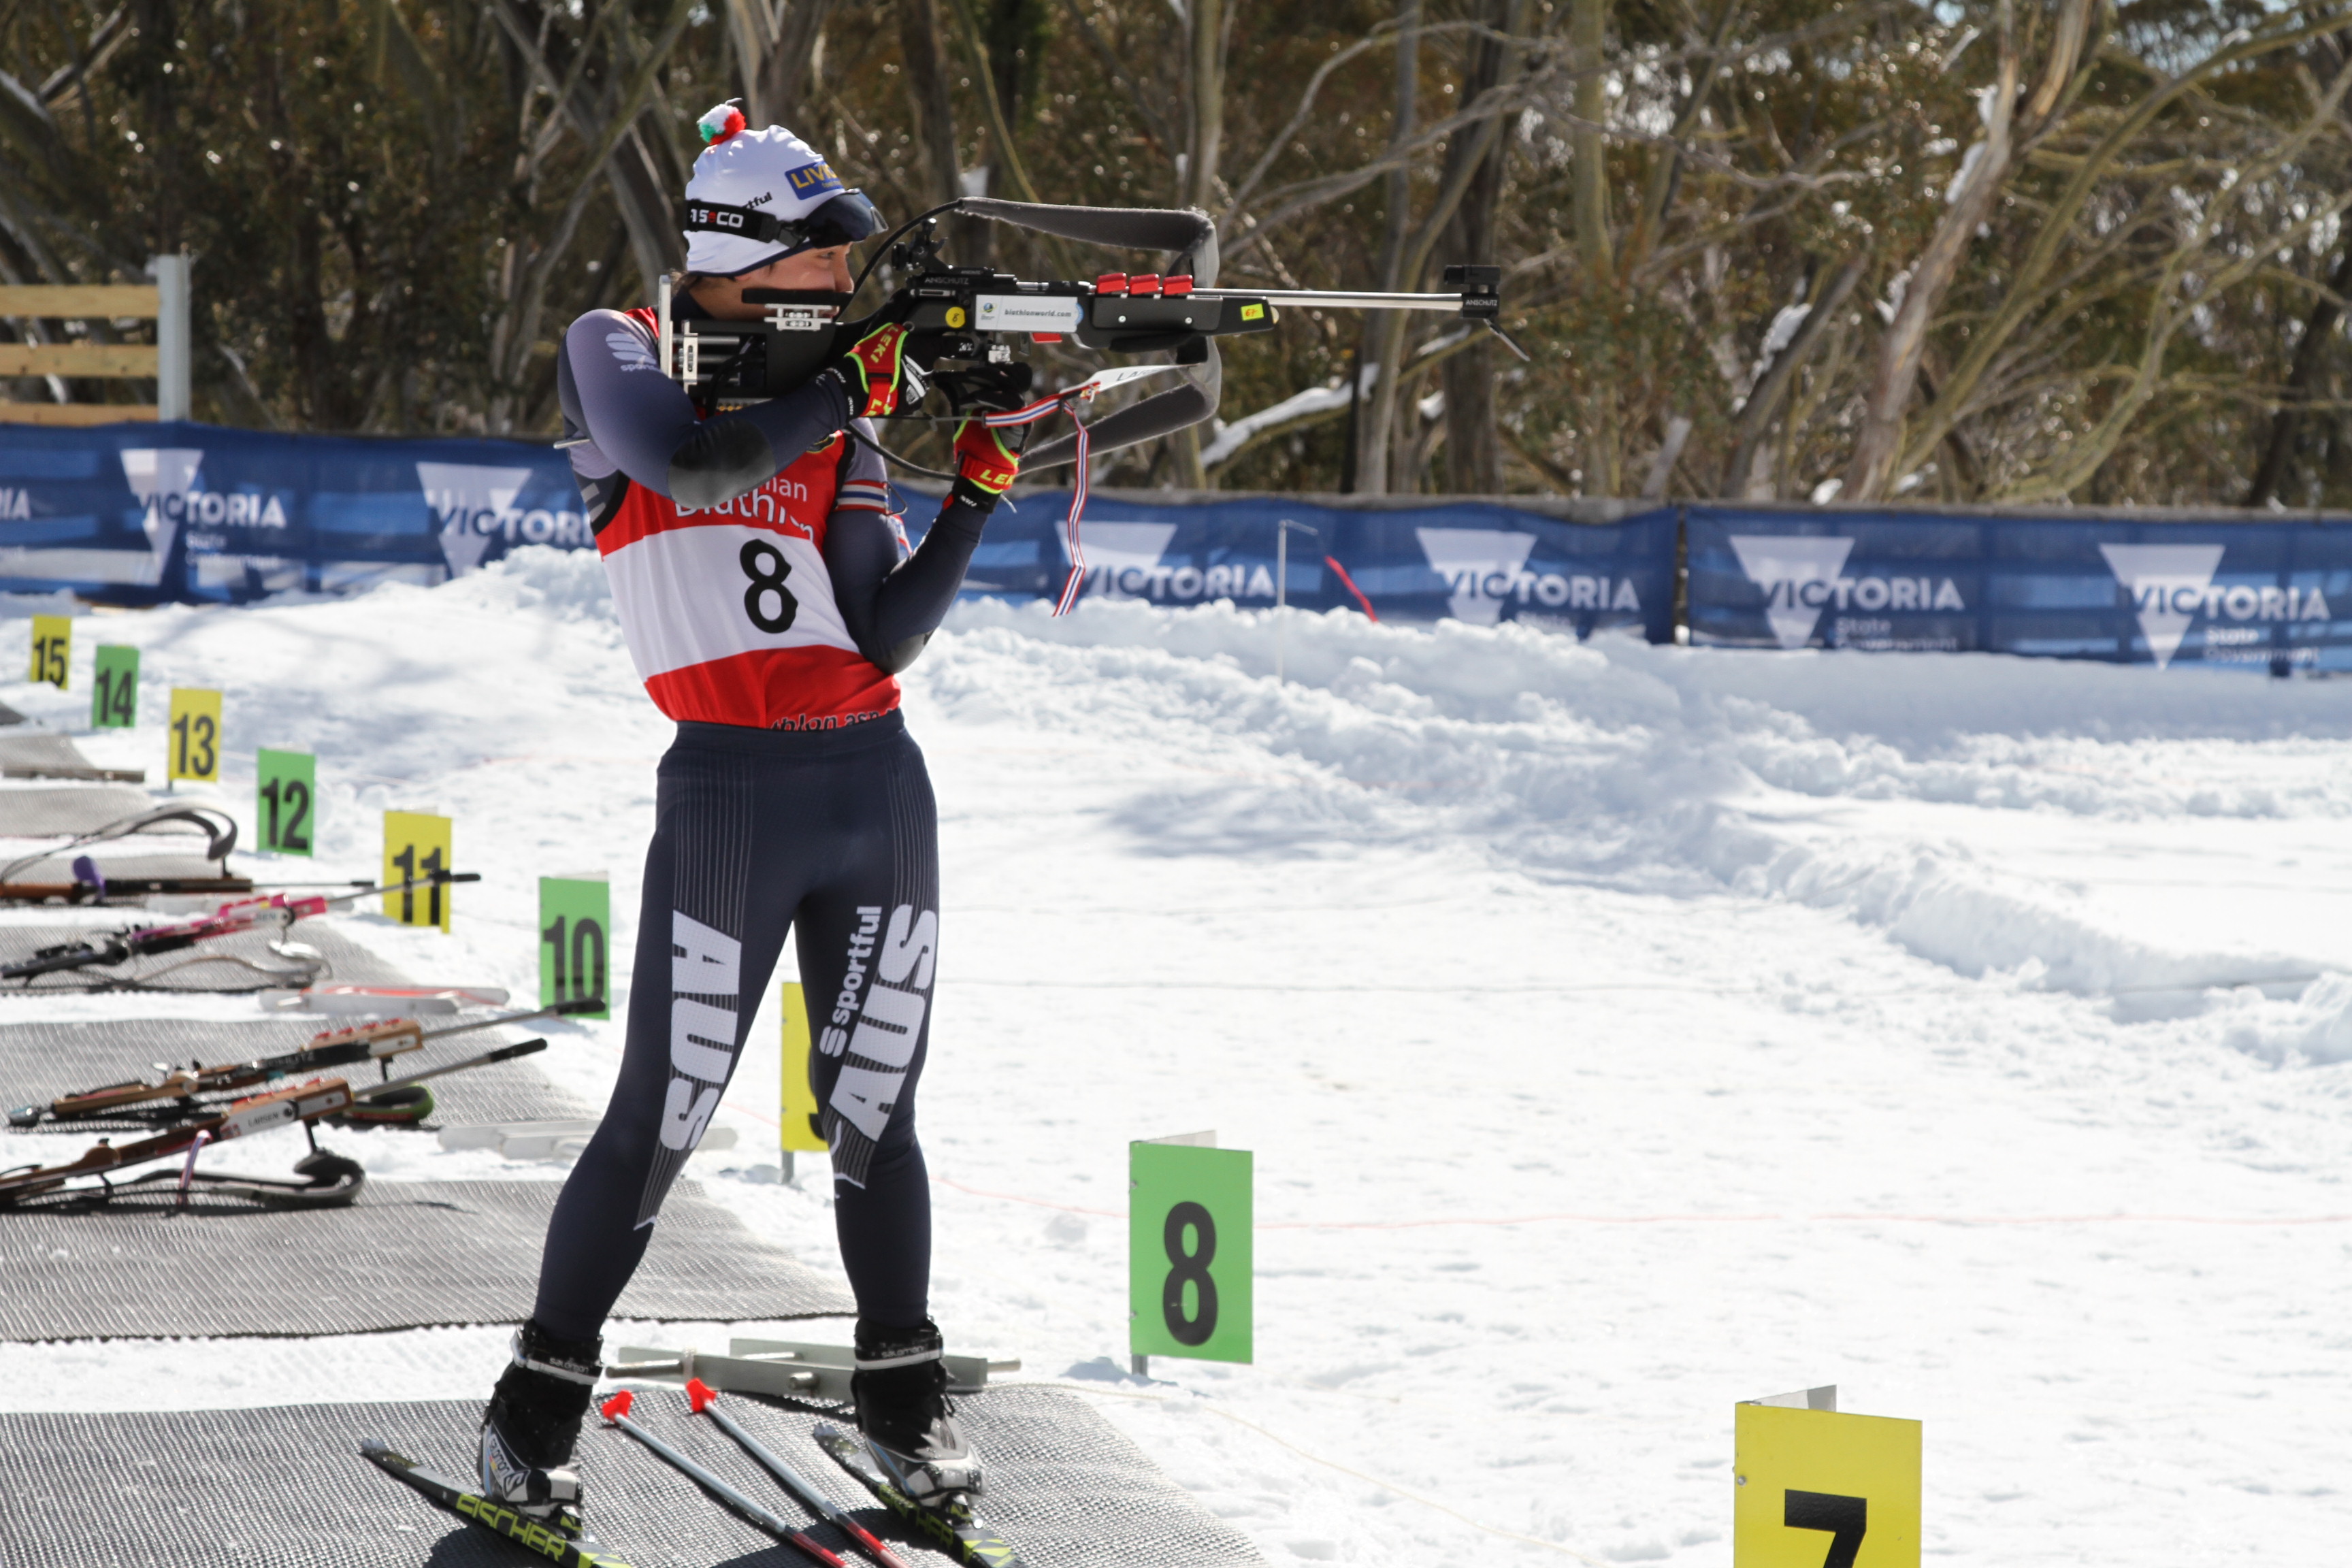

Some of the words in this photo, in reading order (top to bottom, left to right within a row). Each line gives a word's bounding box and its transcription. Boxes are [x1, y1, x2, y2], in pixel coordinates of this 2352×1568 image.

[742, 191, 772, 209] tful
[870, 325, 900, 364] LEKI
[1004, 308, 1072, 318] biathlonworld.com
[135, 491, 287, 529] VICTORIA
[739, 538, 798, 634] 8
[1443, 570, 1641, 612] VICTORIA
[1761, 577, 1965, 610] VICTORIA
[2130, 585, 2331, 621] VICTORIA
[34, 635, 65, 687] 15
[95, 668, 133, 727] 14
[174, 713, 215, 776] 13
[261, 777, 309, 850] 12
[393, 844, 441, 926] 11
[542, 914, 605, 1004] 10
[832, 905, 883, 1026] sportful
[659, 909, 742, 1151] AUS
[829, 904, 938, 1142] AUS
[1163, 1201, 1218, 1347] 8
[456, 1493, 566, 1562] FISCHER
[1784, 1488, 1867, 1568] 7
